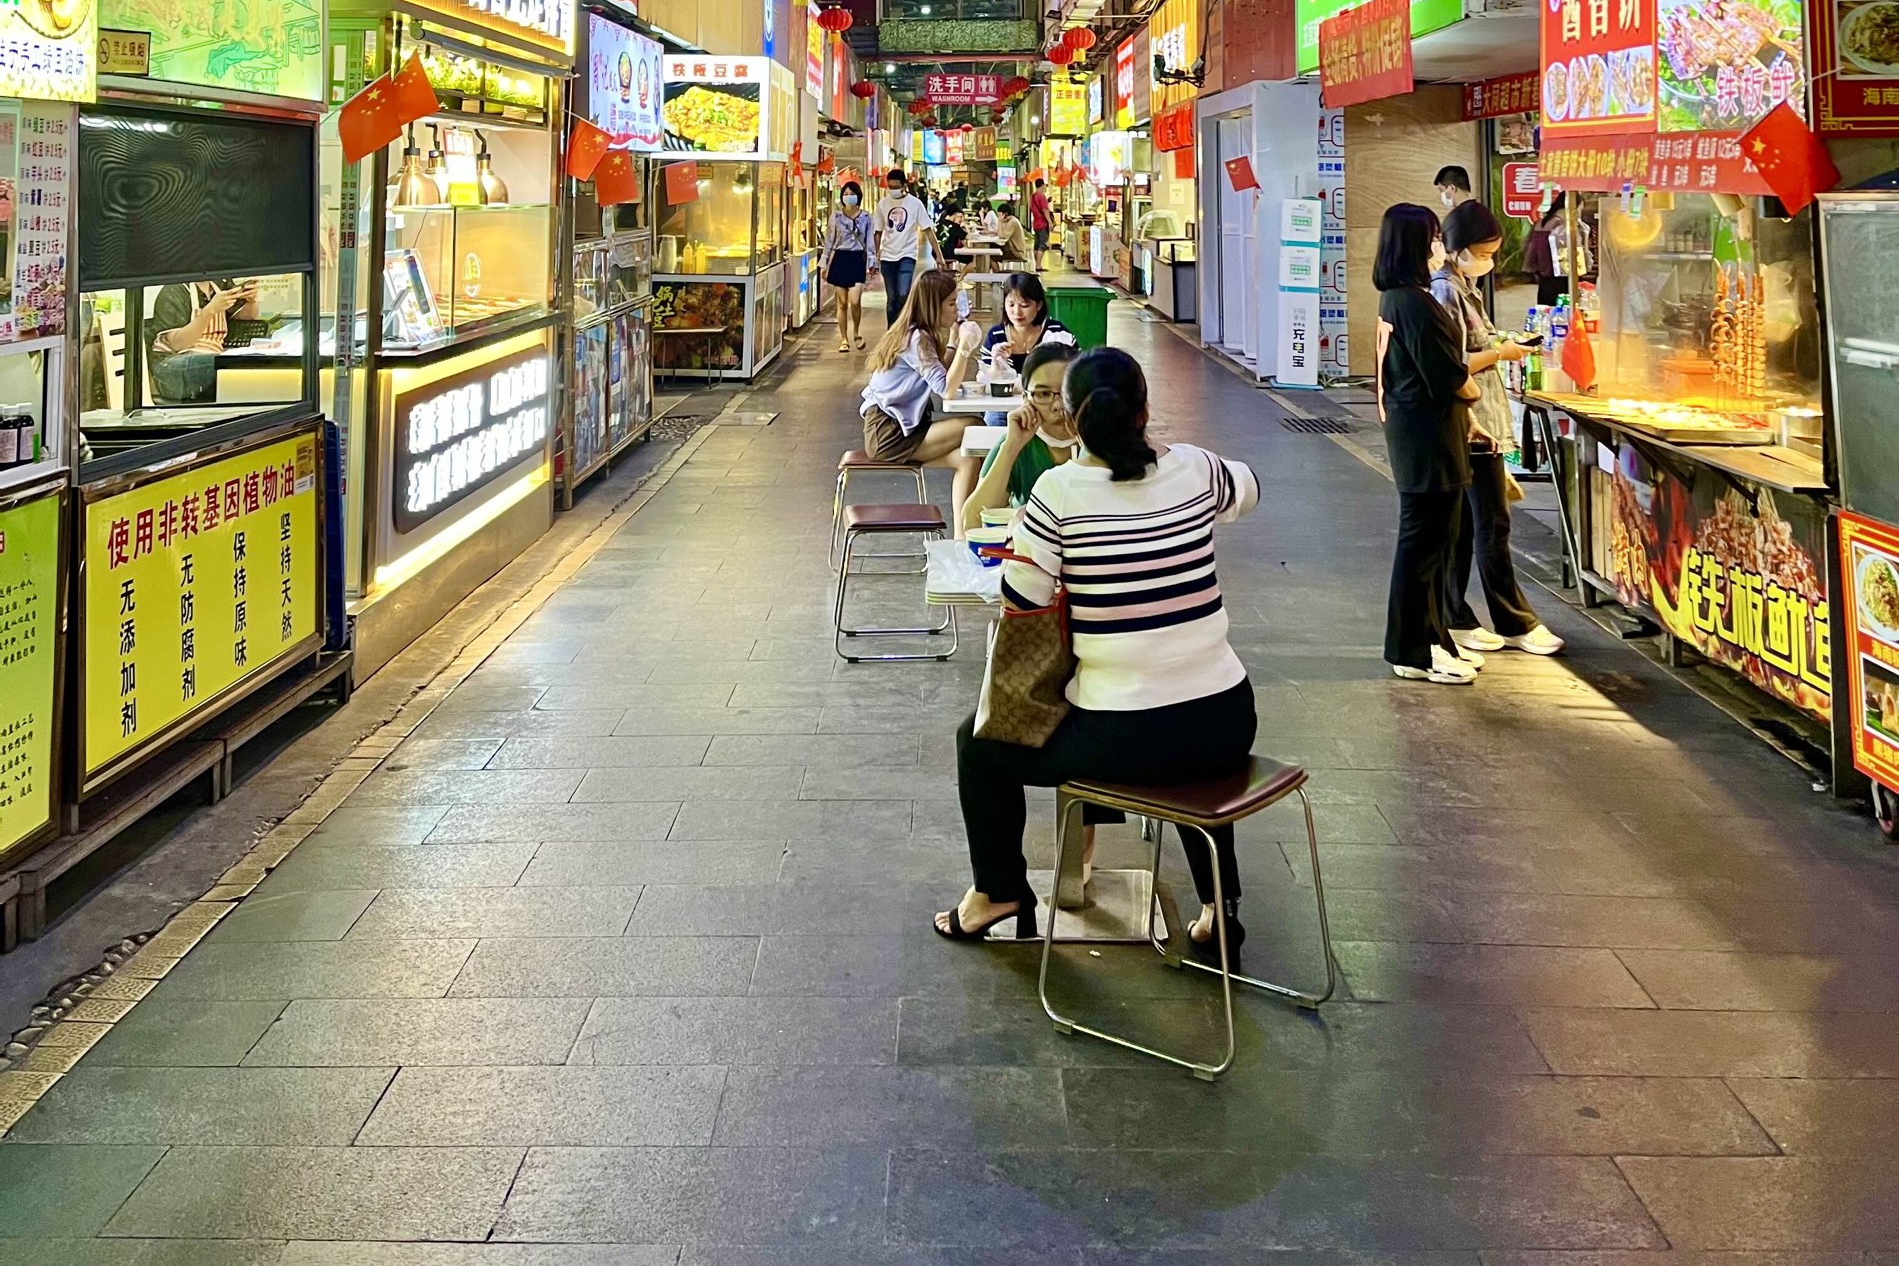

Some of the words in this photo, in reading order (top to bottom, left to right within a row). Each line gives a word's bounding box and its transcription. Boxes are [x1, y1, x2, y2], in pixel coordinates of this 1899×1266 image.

[672, 62, 748, 78] 铁板豆腐
[928, 76, 975, 93] 洗手间
[931, 95, 971, 103] WASHROOM
[107, 458, 295, 570] 使用非转基因植物油
[180, 553, 196, 702] 无防腐剂
[233, 531, 248, 668] 保持原味
[279, 513, 294, 643] 坚持天然
[119, 578, 137, 738] 无添加剂
